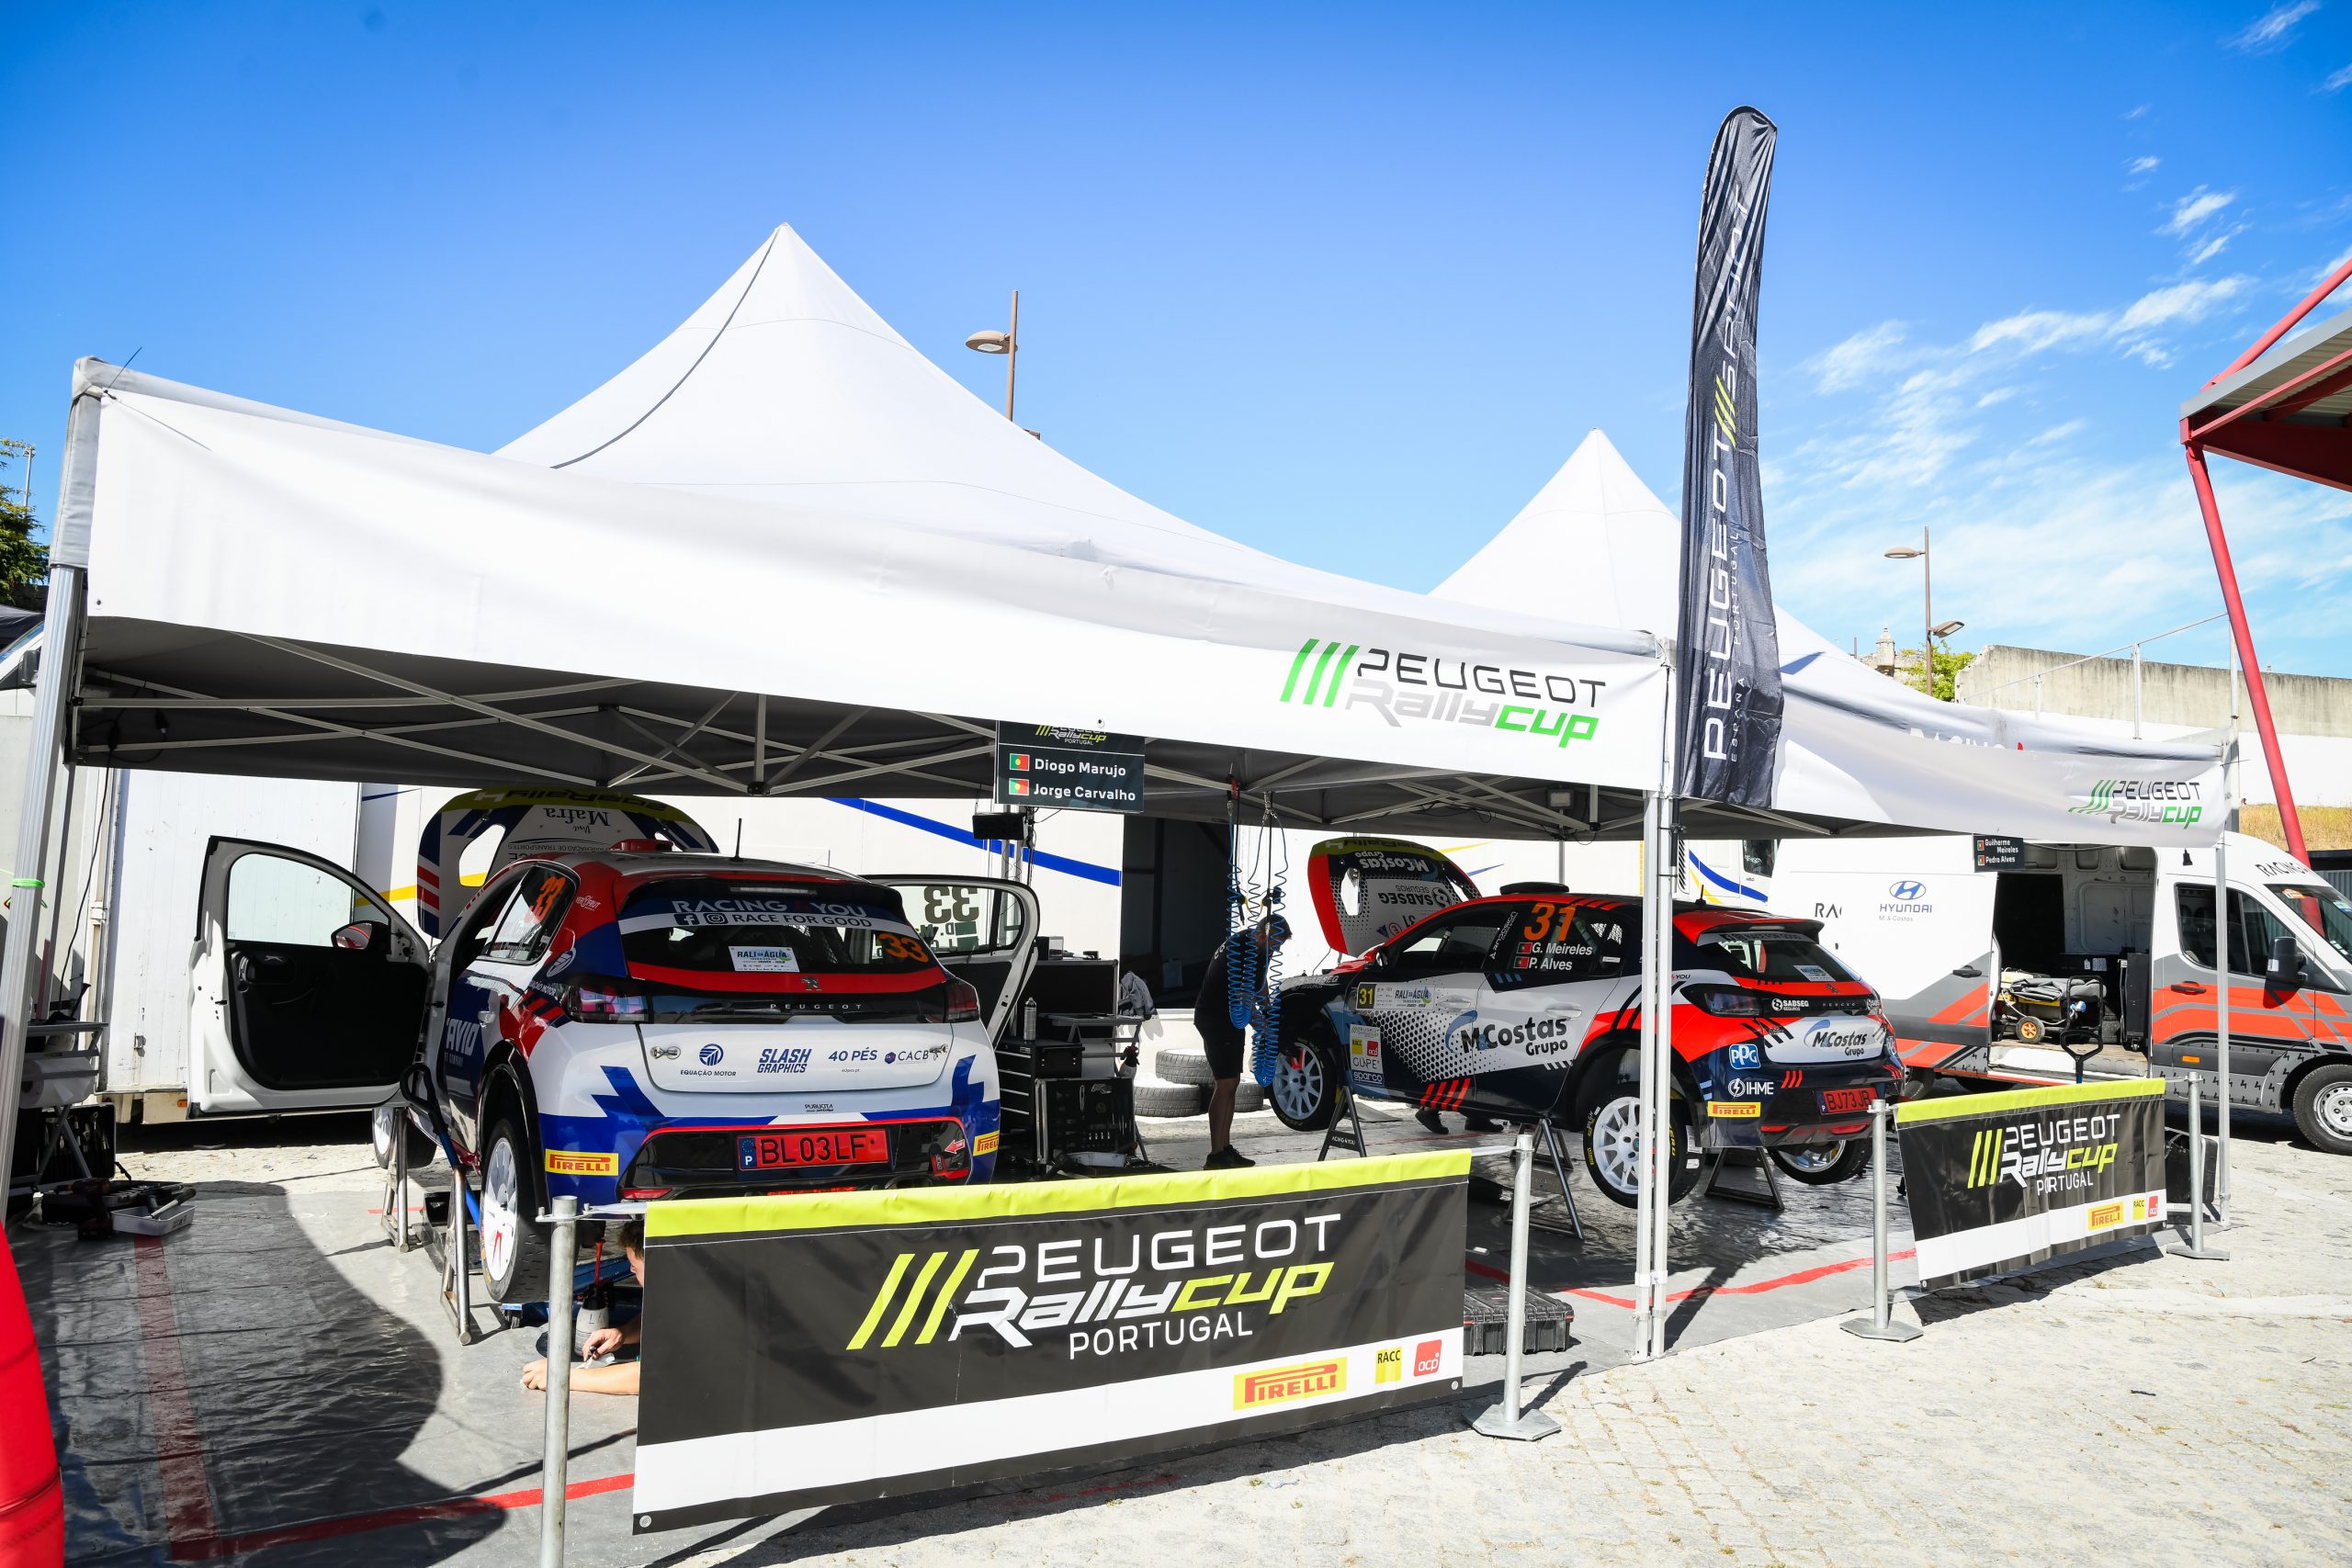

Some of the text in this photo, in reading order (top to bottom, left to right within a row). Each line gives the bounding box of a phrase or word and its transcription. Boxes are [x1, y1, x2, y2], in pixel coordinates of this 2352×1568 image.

[1704, 422, 1733, 761] PEUGEOT
[1730, 532, 1742, 646] PORTUGAL
[1357, 648, 1606, 707] PEUGEOT
[1064, 738, 1093, 746] PORTUGAL
[1035, 758, 1126, 778] Diogo Marujo
[1034, 783, 1136, 802] Jorge Carvalho
[2112, 780, 2200, 801] PEUGEOT
[543, 807, 610, 827] Mafra
[1395, 885, 1430, 893] SEGUROS
[1378, 892, 1434, 906] SABSEG
[672, 899, 866, 918] RACING YOU
[1815, 902, 1842, 919] RA
[1880, 903, 1932, 913] HYUNDAI
[732, 913, 872, 928] RACE FOR GOOD
[1523, 902, 1577, 942] 31
[878, 931, 929, 964] 33
[1532, 942, 1593, 956] G. Meireles
[1529, 957, 1573, 971] P. Alves
[1359, 987, 1374, 1005] 31
[1783, 999, 1809, 1008] SABSEG
[759, 1048, 812, 1064] SLASH
[828, 1046, 877, 1062] 40 PÉS
[1525, 1039, 1568, 1056] Grupo
[1731, 1044, 1758, 1066] PPG
[1845, 1047, 1865, 1056] Grupo
[757, 1063, 808, 1074] GRAPHICS
[1353, 1070, 1383, 1082] sparco
[1747, 1081, 1774, 1095] IHME
[1712, 1104, 1757, 1116] PIRELLI
[2004, 1113, 2120, 1153] PEUGEOT
[548, 1152, 612, 1172] PIRELLI
[744, 1155, 752, 1166] P
[2036, 1170, 2094, 1196] PORTUGAL
[2133, 1199, 2144, 1208] RACC
[2091, 1204, 2120, 1227] PIRELLI
[980, 1213, 1341, 1289] PEUGEOT
[1069, 1311, 1253, 1360] PORTUGAL
[1377, 1350, 1401, 1364] RACC
[1417, 1351, 1441, 1376] acp
[1244, 1363, 1338, 1404] PIRELLI
